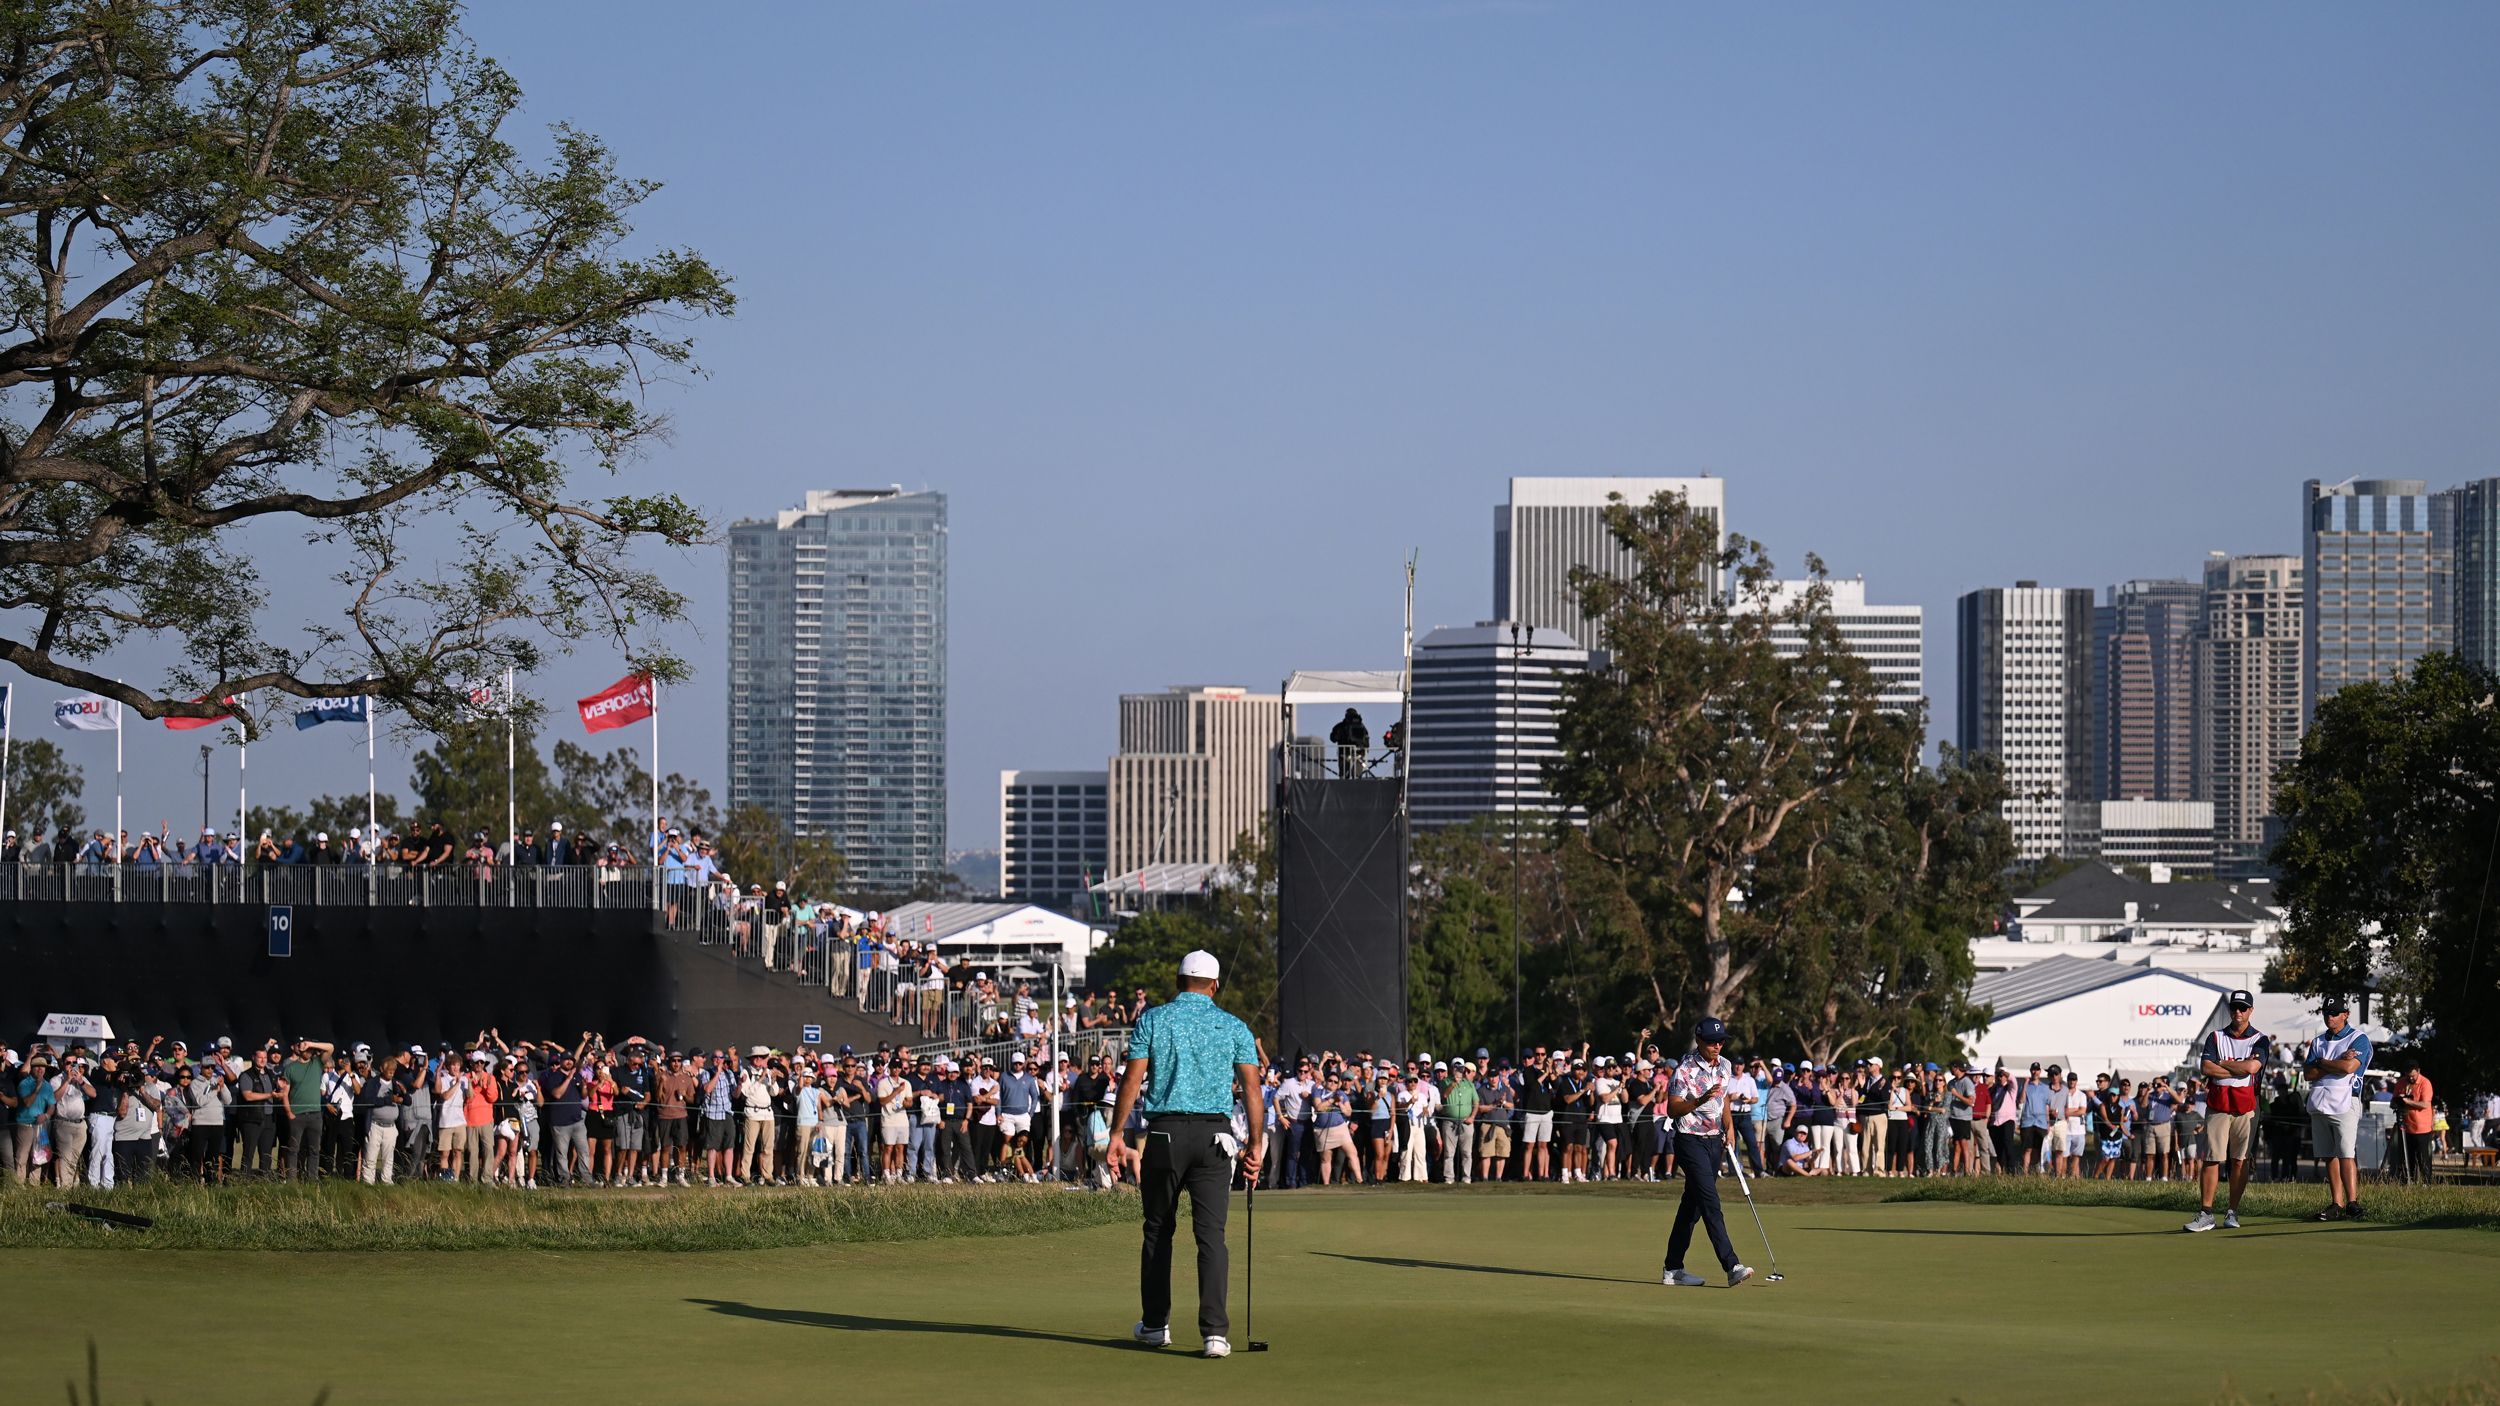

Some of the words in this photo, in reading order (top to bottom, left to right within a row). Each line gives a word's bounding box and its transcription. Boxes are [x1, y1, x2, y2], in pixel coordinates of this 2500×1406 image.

[272, 915, 289, 931] 10
[2328, 998, 2335, 1007] P
[2139, 1004, 2191, 1016] USOPEN
[60, 1016, 87, 1026] COURSE
[1714, 1023, 1720, 1032] P
